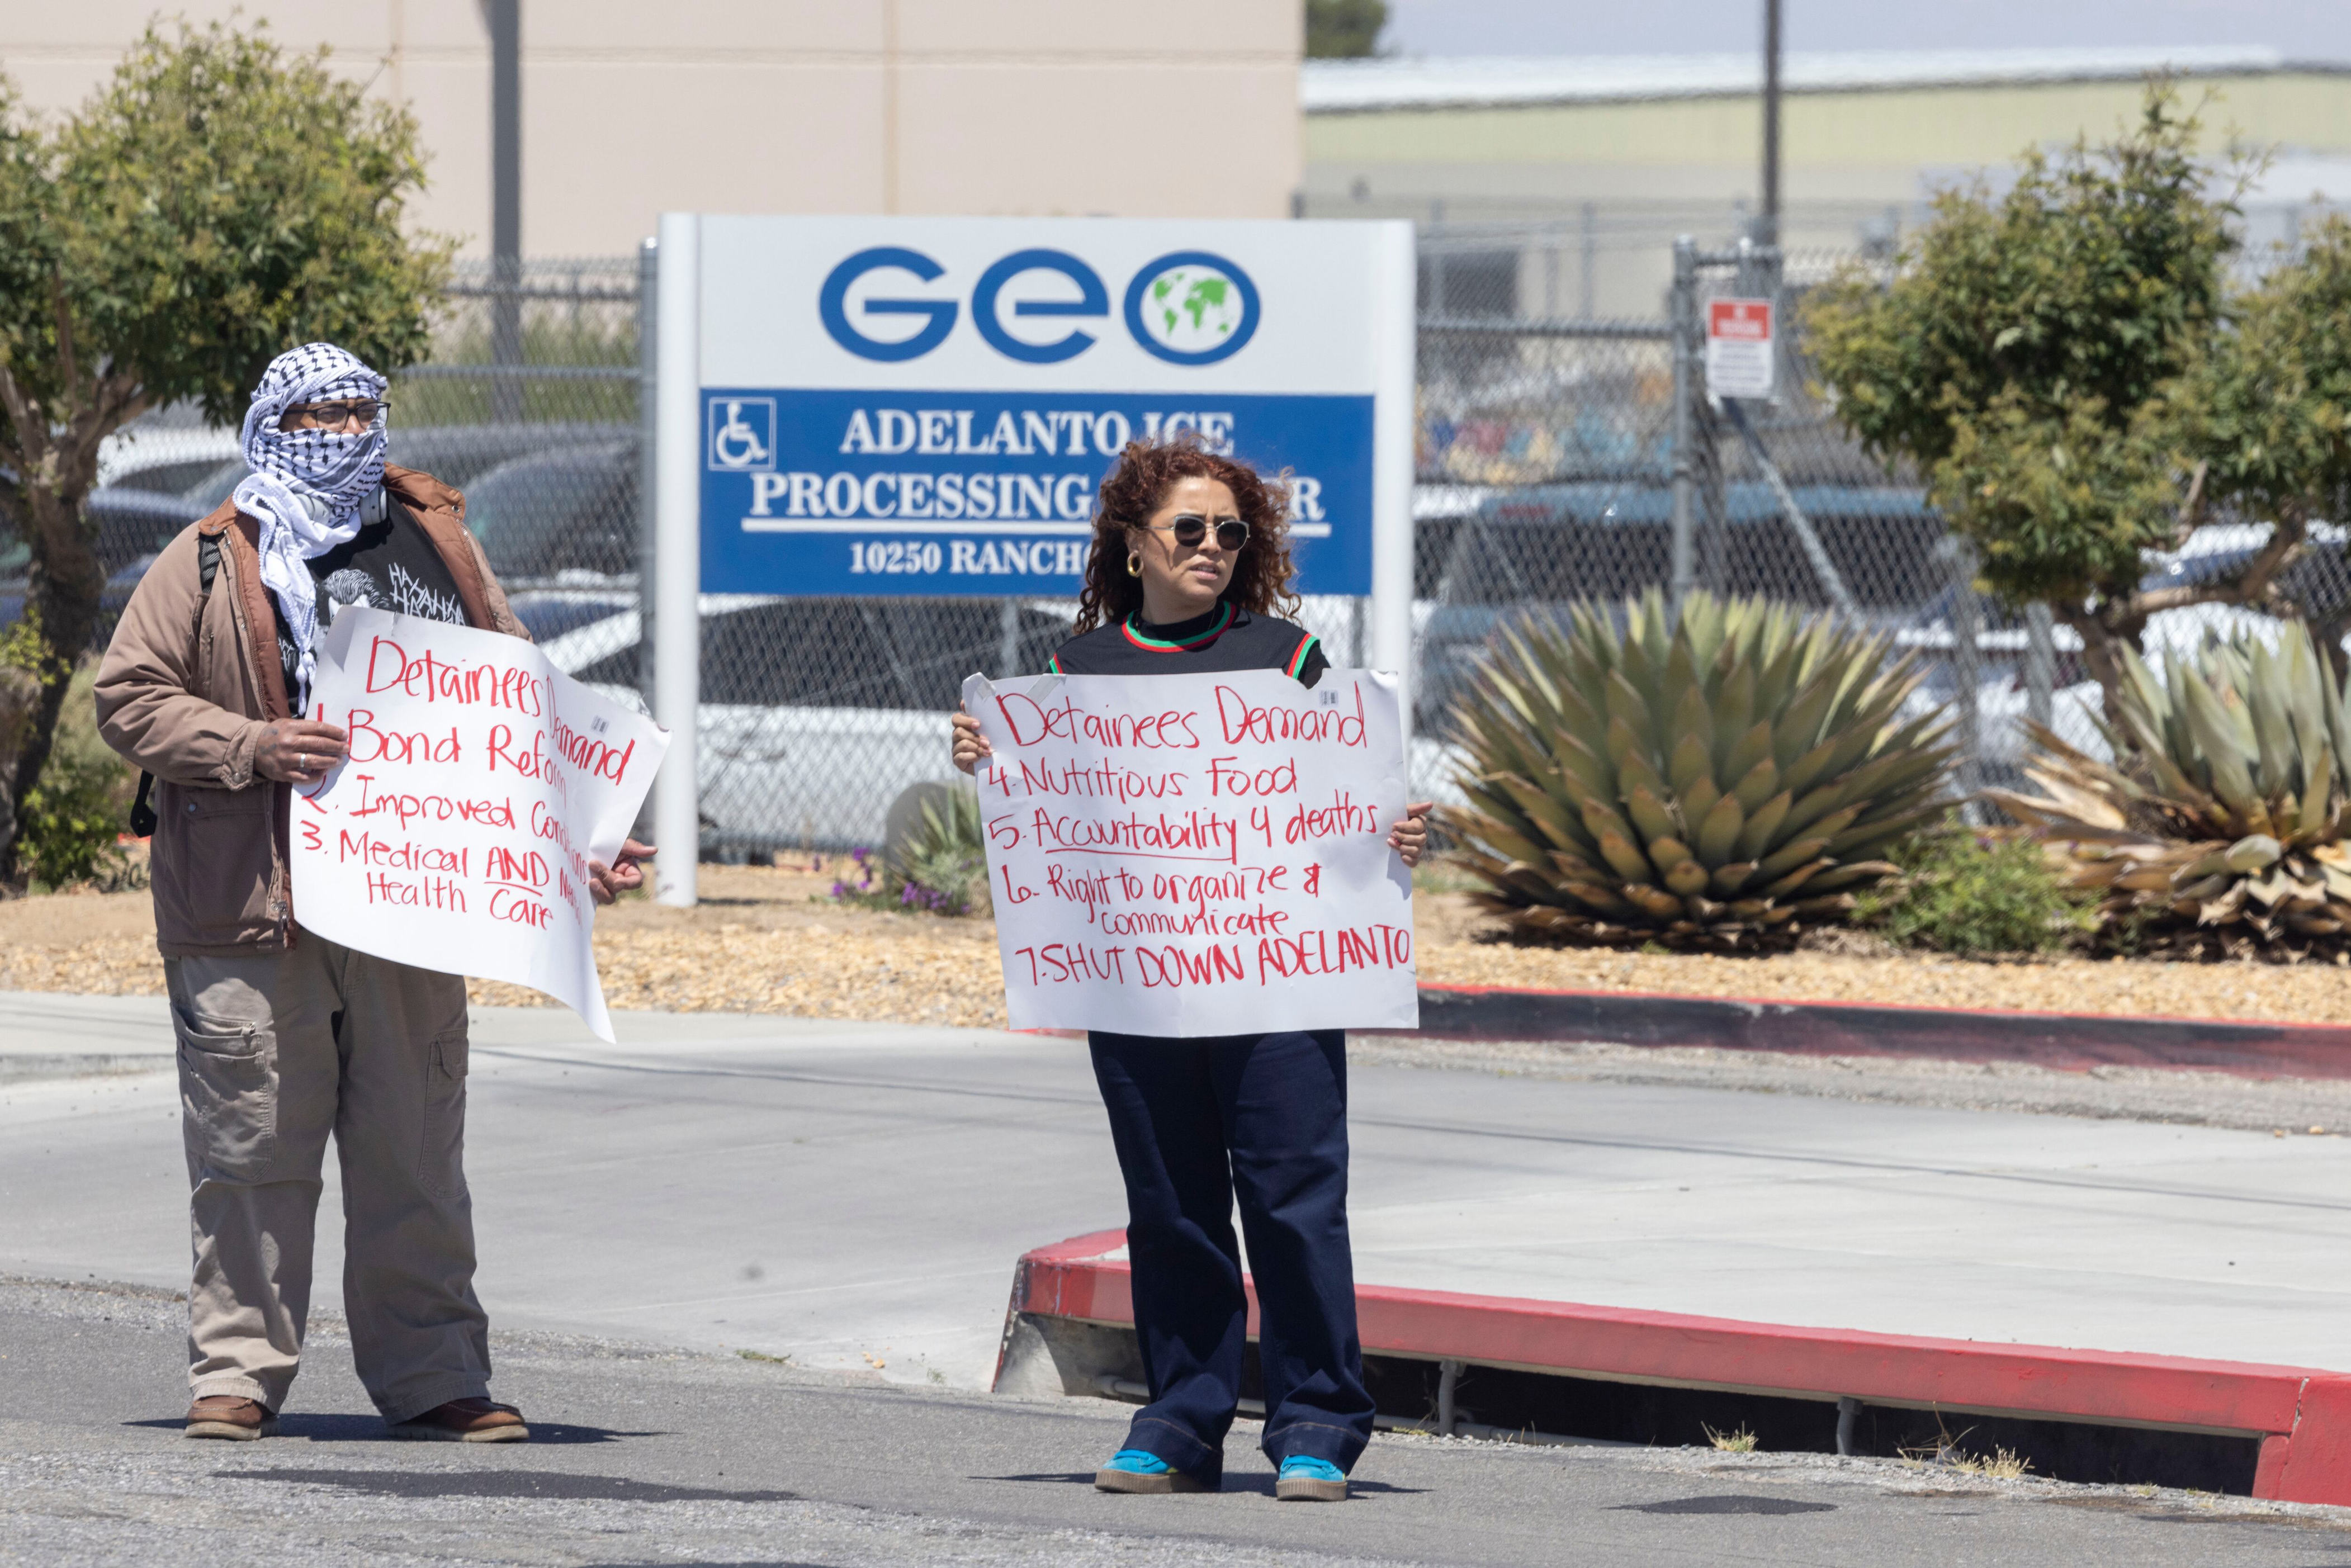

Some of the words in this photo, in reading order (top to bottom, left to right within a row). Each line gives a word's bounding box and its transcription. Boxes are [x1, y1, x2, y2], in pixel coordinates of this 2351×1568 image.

[840, 409, 1132, 457] ADELANTO
[750, 472, 1093, 520] PROCESSING
[849, 541, 943, 575] 10250
[949, 540, 1091, 575] RANCH
[366, 635, 543, 718] Detainees
[546, 674, 635, 786] Demand
[996, 693, 1200, 749] Detainees
[1214, 681, 1368, 748] Demand
[347, 708, 461, 765] Bond
[486, 724, 566, 809] Reform
[1019, 756, 1189, 805] Nutritious
[1205, 756, 1298, 797] Food
[349, 774, 516, 831] Improved
[1031, 806, 1237, 866] Accountability
[1285, 789, 1378, 845] deaths
[300, 819, 328, 855] 3.
[340, 829, 468, 878] Medical
[485, 846, 550, 888] AND
[366, 871, 466, 913] Health
[489, 888, 554, 930] Care
[1047, 863, 1111, 924] Right
[1113, 866, 1144, 902] to
[1152, 864, 1289, 922] organize
[1101, 903, 1289, 937] communicate
[1136, 943, 1245, 989] DOWN
[1258, 923, 1411, 986] ADELANTO
